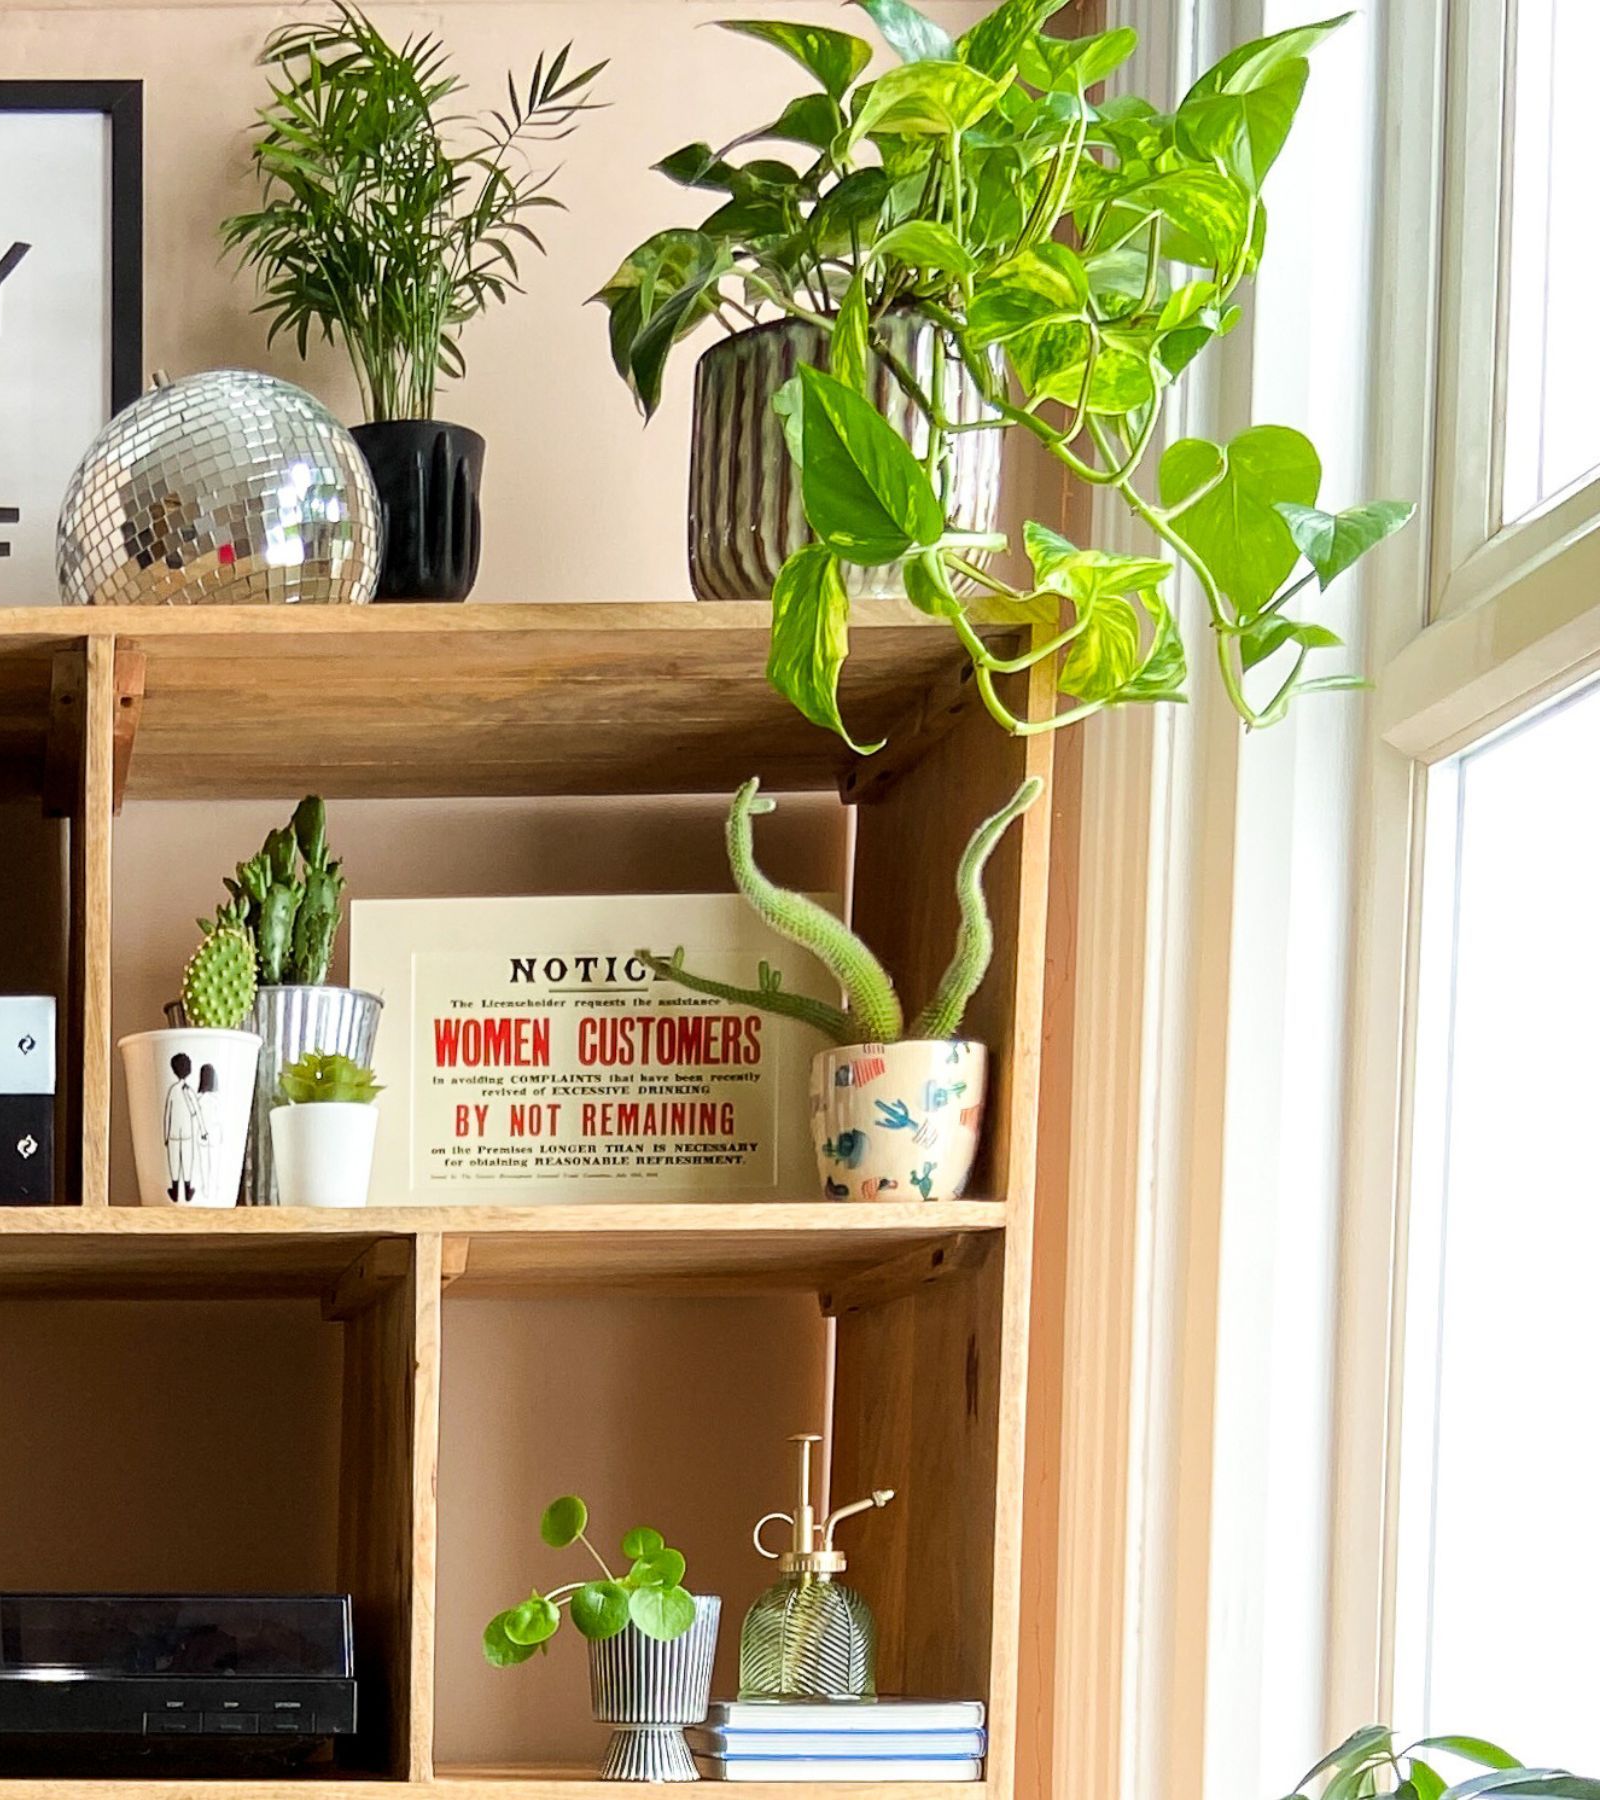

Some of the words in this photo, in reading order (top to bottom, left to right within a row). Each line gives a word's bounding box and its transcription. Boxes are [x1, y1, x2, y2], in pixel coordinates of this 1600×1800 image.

[450, 999, 474, 1008] The
[574, 998, 626, 1010] requests
[632, 998, 652, 1007] the
[434, 1017, 550, 1067] WOMEN
[578, 1015, 762, 1067] CUSTOMERS
[450, 1075, 504, 1085] avoiding
[510, 1074, 602, 1085] COMPLAINTS
[609, 1074, 634, 1083] that
[640, 1073, 669, 1083] have
[675, 1073, 703, 1082] been
[710, 1071, 761, 1083] recently
[533, 1086, 546, 1096] of
[552, 1086, 630, 1096] EXCESSIVE
[638, 1085, 710, 1095] DRINKING
[455, 1104, 489, 1137] BY
[510, 1104, 561, 1137] NOT
[582, 1103, 734, 1137] REMAINING
[431, 1147, 446, 1155] on
[452, 1146, 471, 1155] the
[477, 1145, 533, 1155] Premises
[539, 1144, 597, 1154] LONGER
[605, 1144, 644, 1153] THAN
[653, 1143, 667, 1153] IS
[674, 1142, 759, 1153] NECESSARY
[444, 1158, 463, 1167] for
[469, 1158, 528, 1168] obtaining
[534, 1156, 630, 1166] REASONABLE
